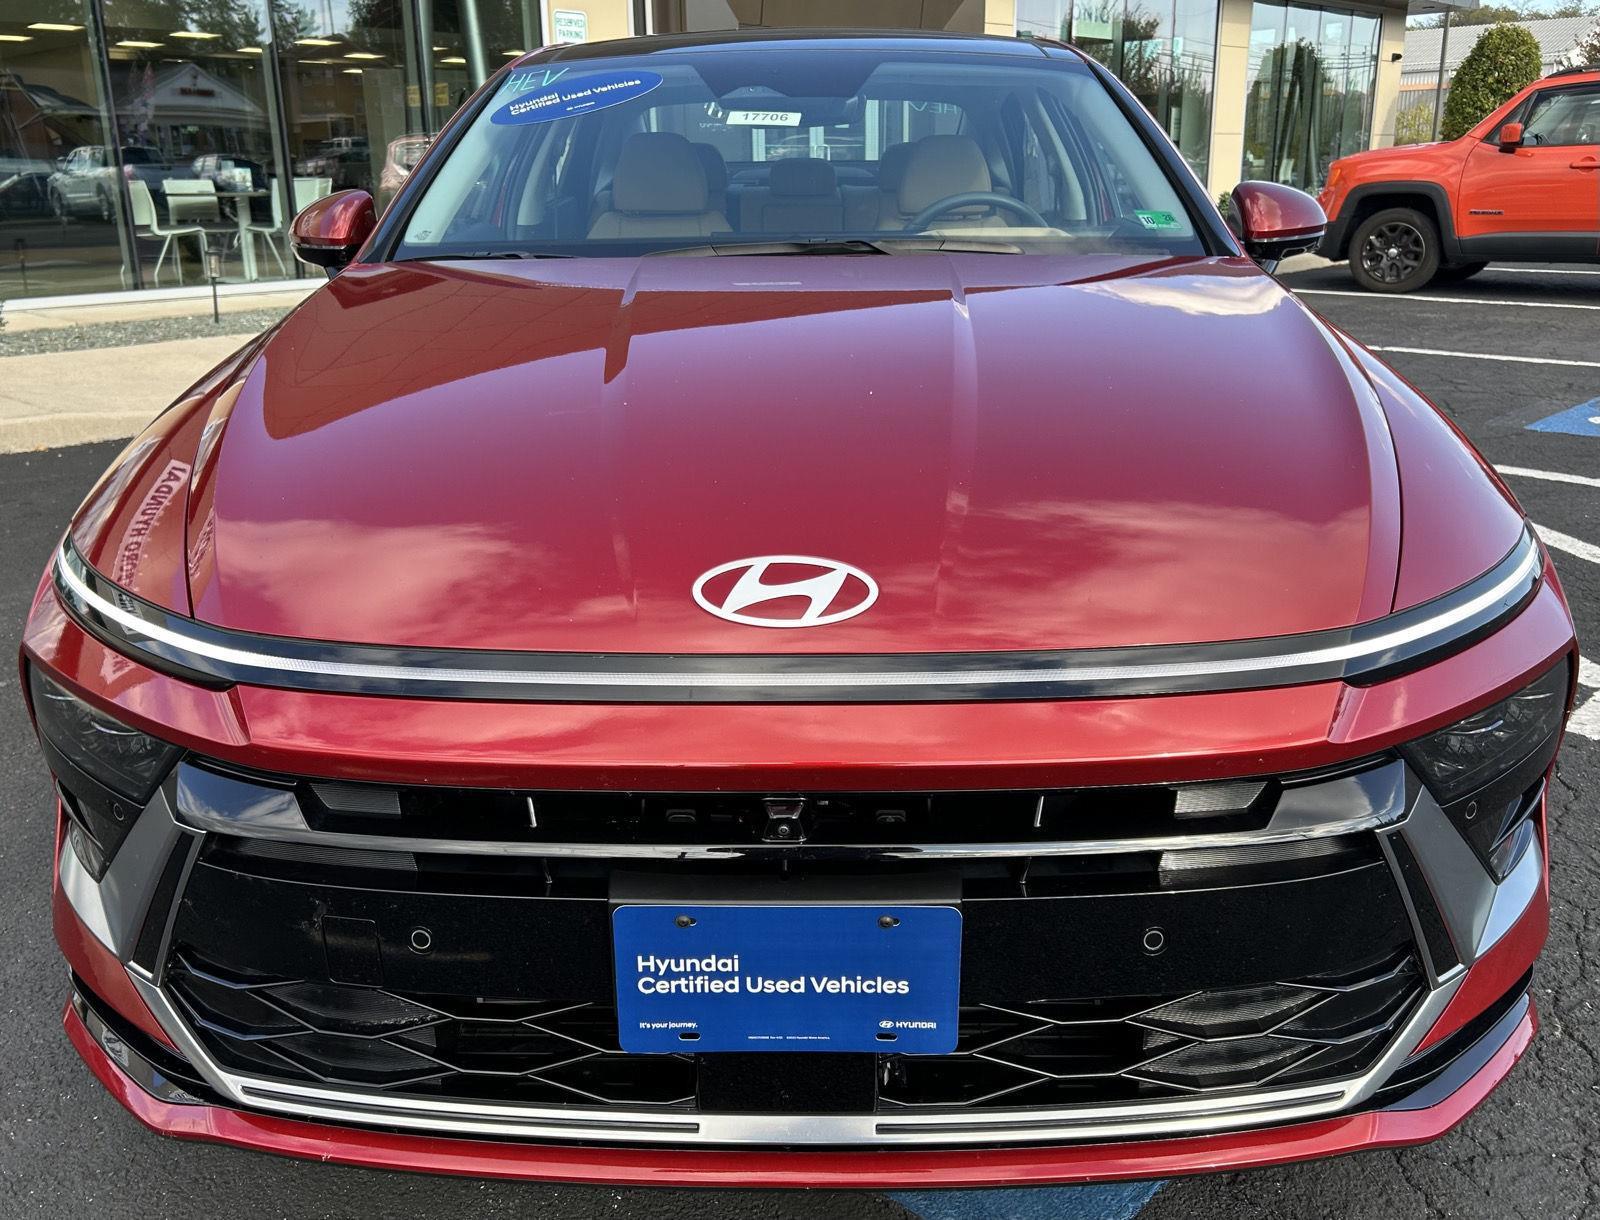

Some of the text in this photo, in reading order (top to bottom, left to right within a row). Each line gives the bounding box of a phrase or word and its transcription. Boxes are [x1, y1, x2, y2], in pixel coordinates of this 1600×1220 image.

[500, 67, 570, 95] HEV
[562, 89, 592, 101] Used
[593, 79, 642, 94] Vehicles
[510, 92, 559, 111] Hyundai
[742, 113, 789, 122] 17706
[1142, 216, 1155, 225] 10
[637, 954, 740, 976] Hyundai
[637, 975, 910, 994] Certified Used Vehicles
[651, 1022, 668, 1030] your
[668, 1021, 698, 1030] journey.
[895, 1021, 937, 1029] HYUNDAI
